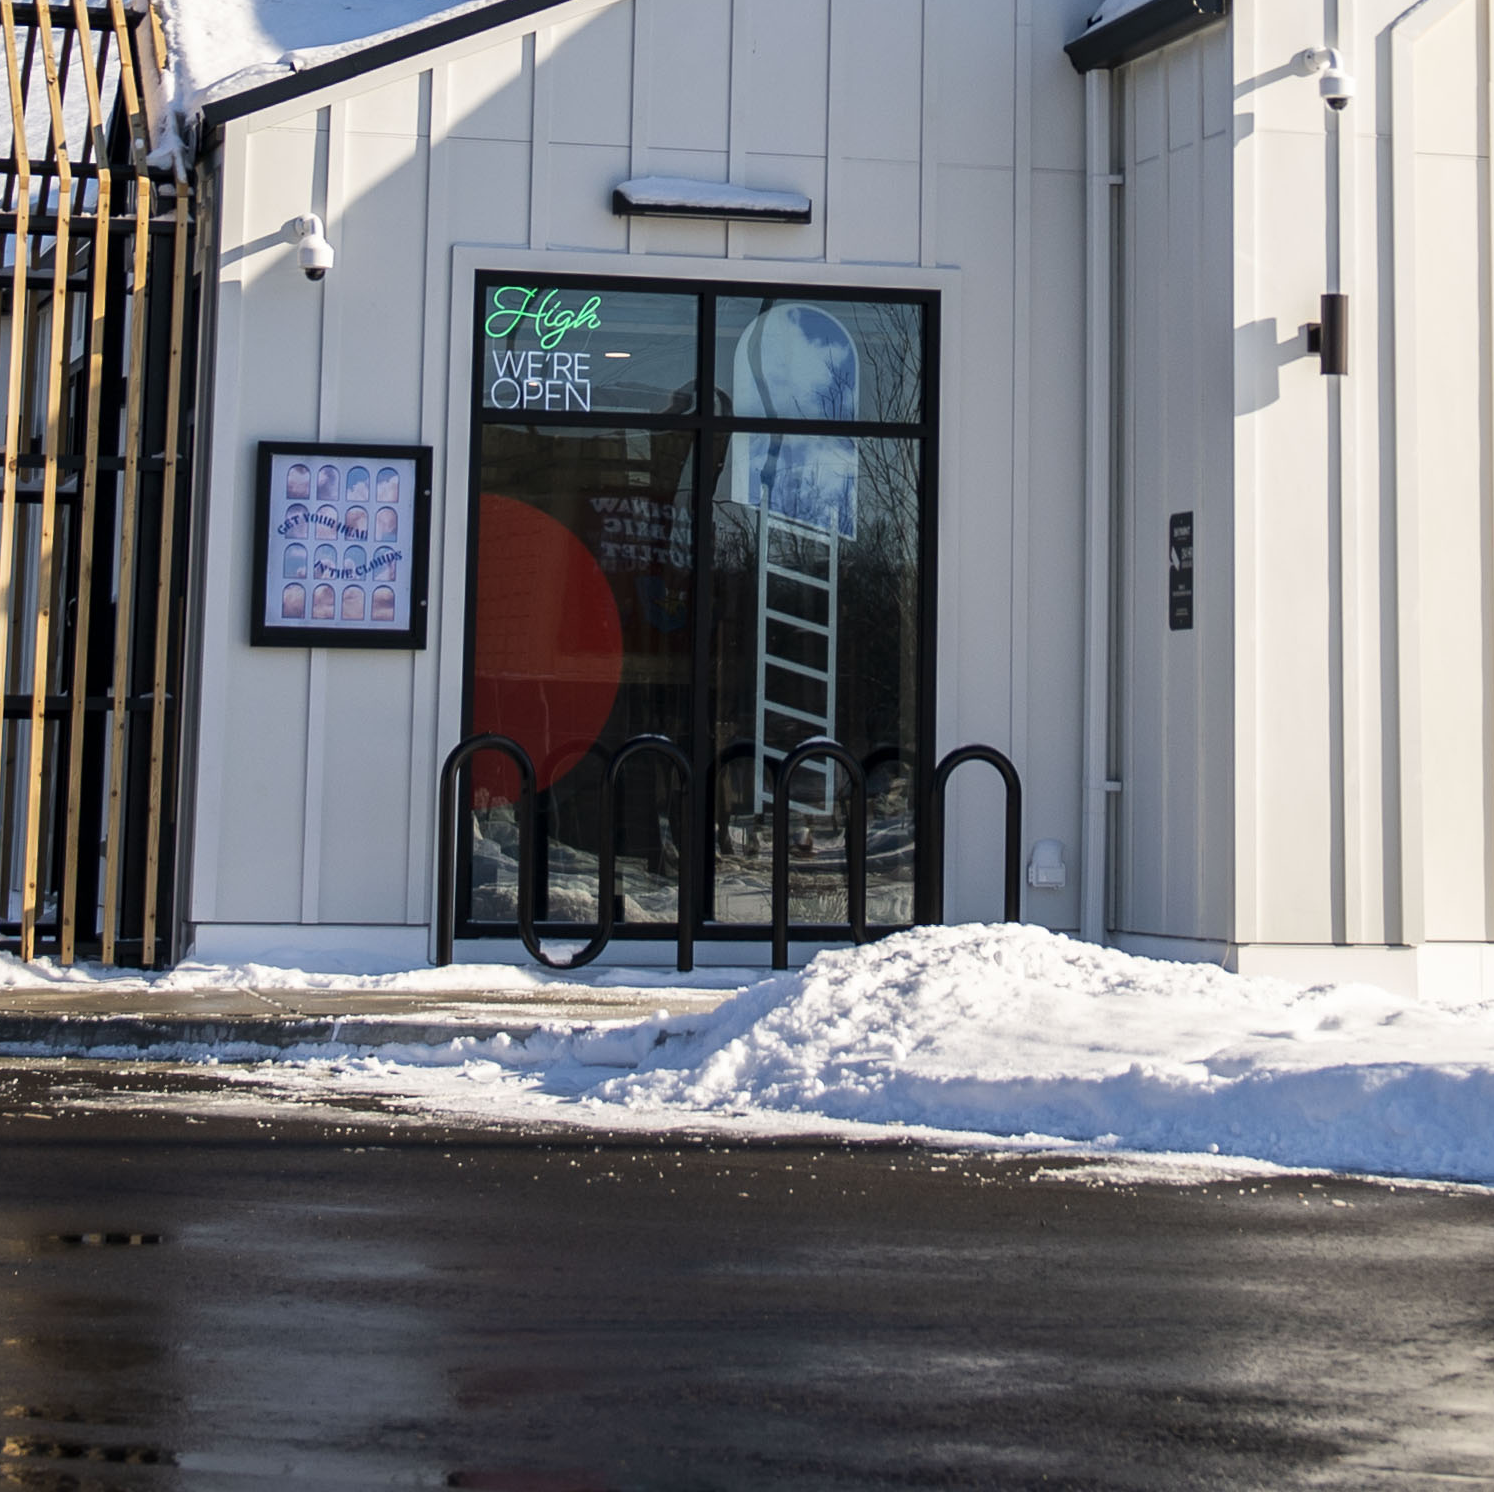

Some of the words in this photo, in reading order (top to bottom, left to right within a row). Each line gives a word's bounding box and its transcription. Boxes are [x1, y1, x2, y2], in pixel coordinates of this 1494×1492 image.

[485, 286, 601, 349] High
[492, 350, 591, 383] WE'RE
[491, 377, 591, 412] OPEN
[277, 515, 300, 536] GET
[303, 512, 336, 529] YOUR
[336, 522, 369, 541] HEAD
[313, 560, 328, 574] IN
[328, 566, 354, 579] THE
[355, 550, 403, 576] CLOUDS
